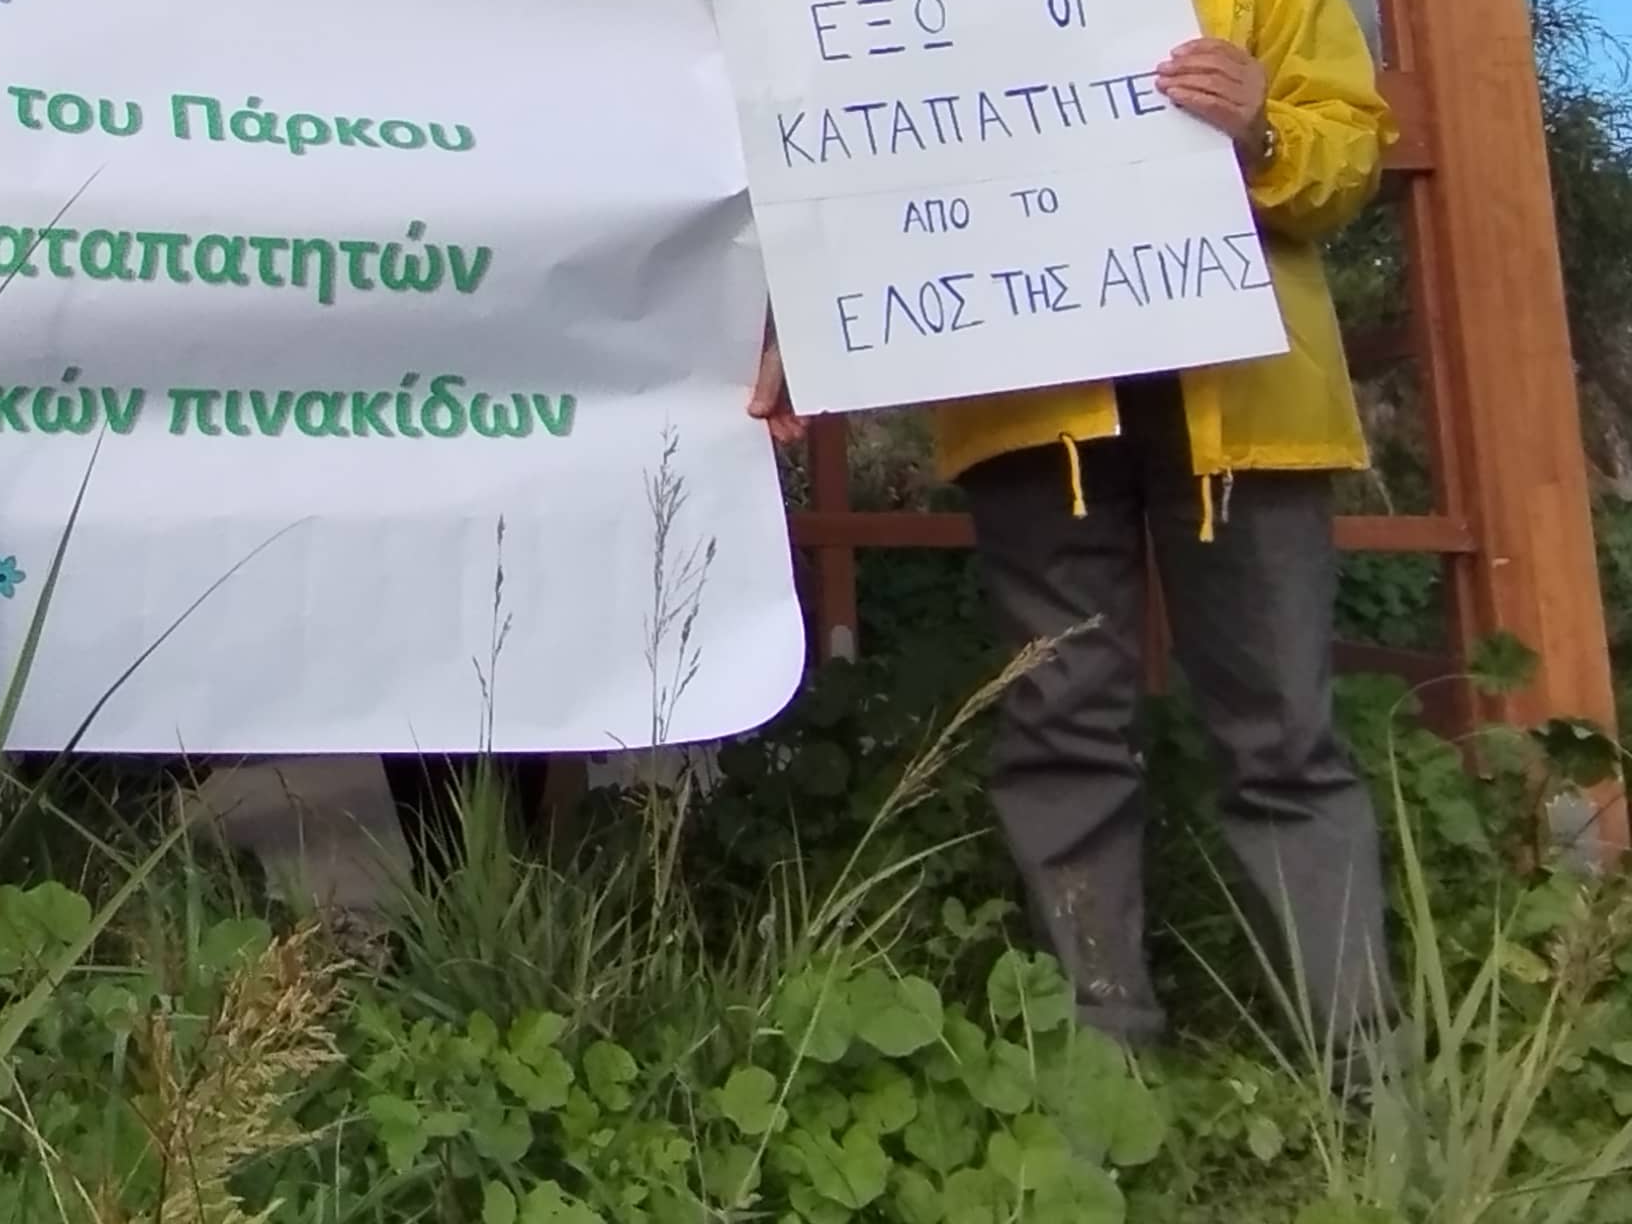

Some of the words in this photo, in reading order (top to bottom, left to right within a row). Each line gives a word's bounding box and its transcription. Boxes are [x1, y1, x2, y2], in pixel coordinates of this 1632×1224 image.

[6, 84, 144, 140] του
[170, 94, 477, 156] Πάρκου
[776, 69, 1176, 168] ΚΑΤΑΠΑΤΗΤΕ
[902, 197, 971, 234] ΑΠΟ
[1009, 186, 1060, 219] ΤΟ
[836, 272, 986, 353] ΕΛΟΣ
[990, 263, 1083, 317] ΤΗΣ
[167, 372, 578, 441] πινακίδων
